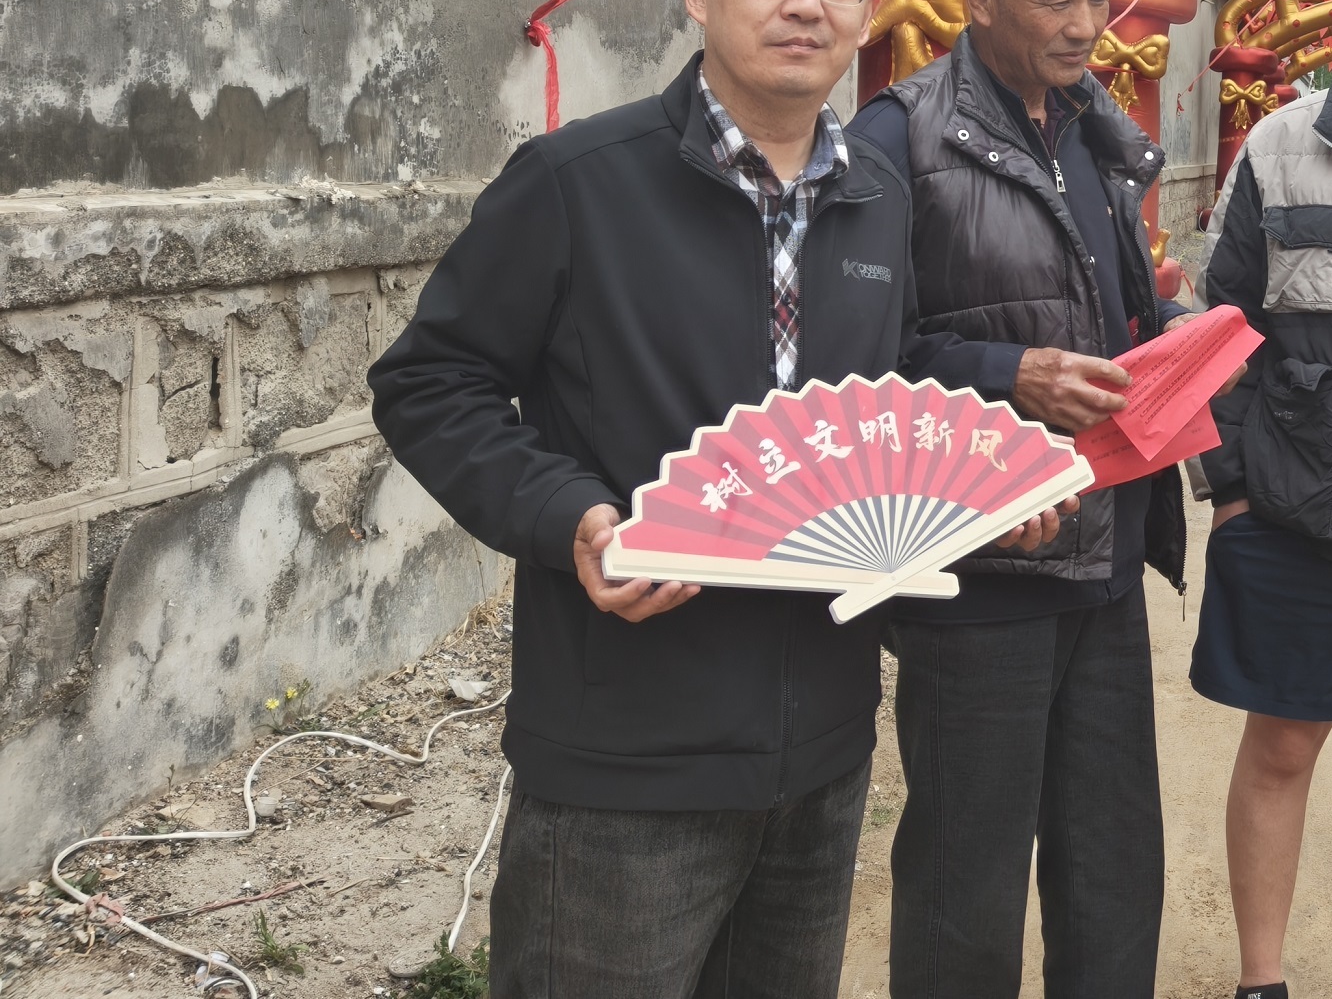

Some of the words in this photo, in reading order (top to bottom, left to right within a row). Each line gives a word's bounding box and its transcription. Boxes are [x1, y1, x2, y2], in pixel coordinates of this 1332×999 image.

[701, 411, 1008, 513] 树立文明新风
